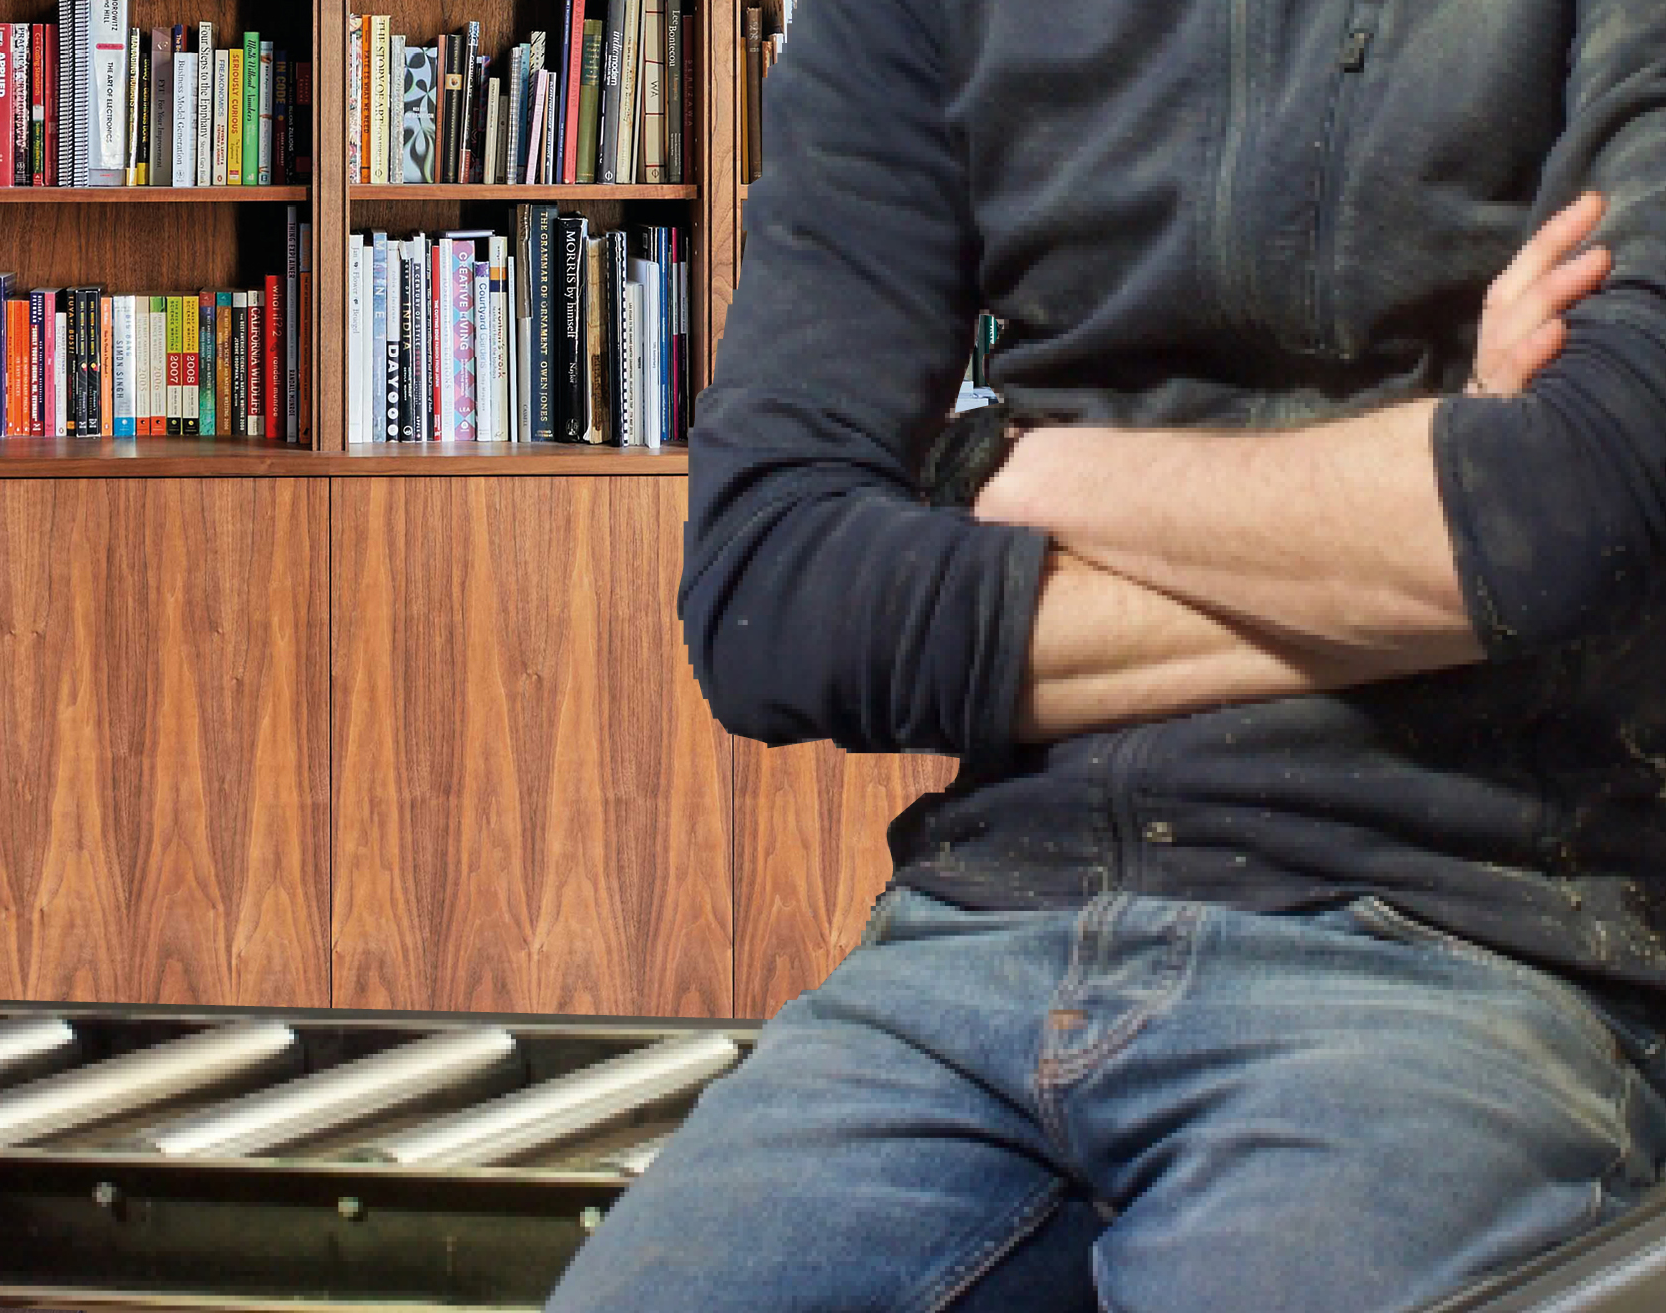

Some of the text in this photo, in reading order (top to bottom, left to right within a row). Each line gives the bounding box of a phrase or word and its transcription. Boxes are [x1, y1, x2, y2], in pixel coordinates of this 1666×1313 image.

[458, 252, 468, 349] CREATIVE LIVING
[541, 286, 547, 296] OF
[565, 230, 576, 338] MORRIS by himself
[170, 355, 179, 383] 2007
[251, 308, 259, 414] CALIFORNIA WILDLIFE
